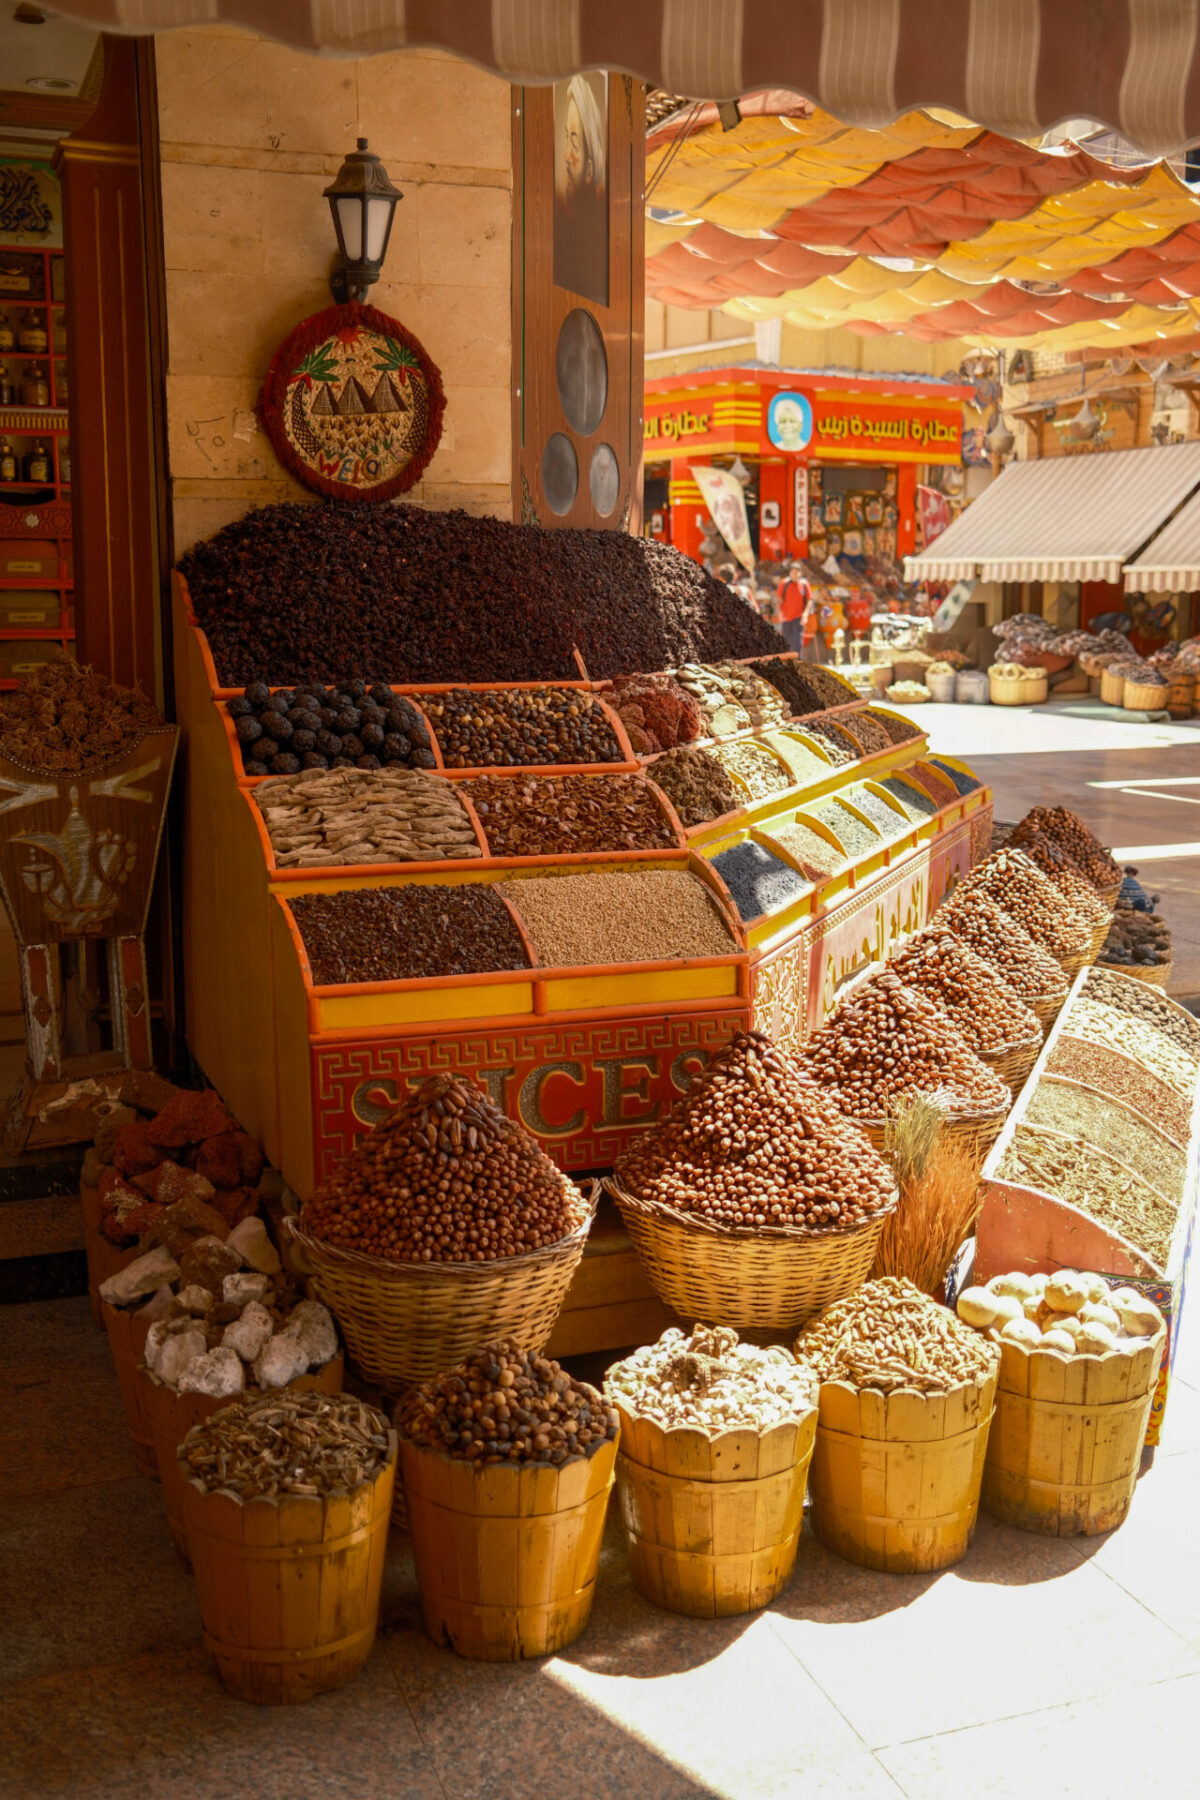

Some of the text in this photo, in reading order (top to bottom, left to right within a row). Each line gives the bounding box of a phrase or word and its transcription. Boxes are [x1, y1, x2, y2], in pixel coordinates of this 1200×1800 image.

[661, 411, 709, 442] عطارة
[816, 415, 958, 446] عطارة السيدة زينب
[796, 468, 806, 539] SPICES
